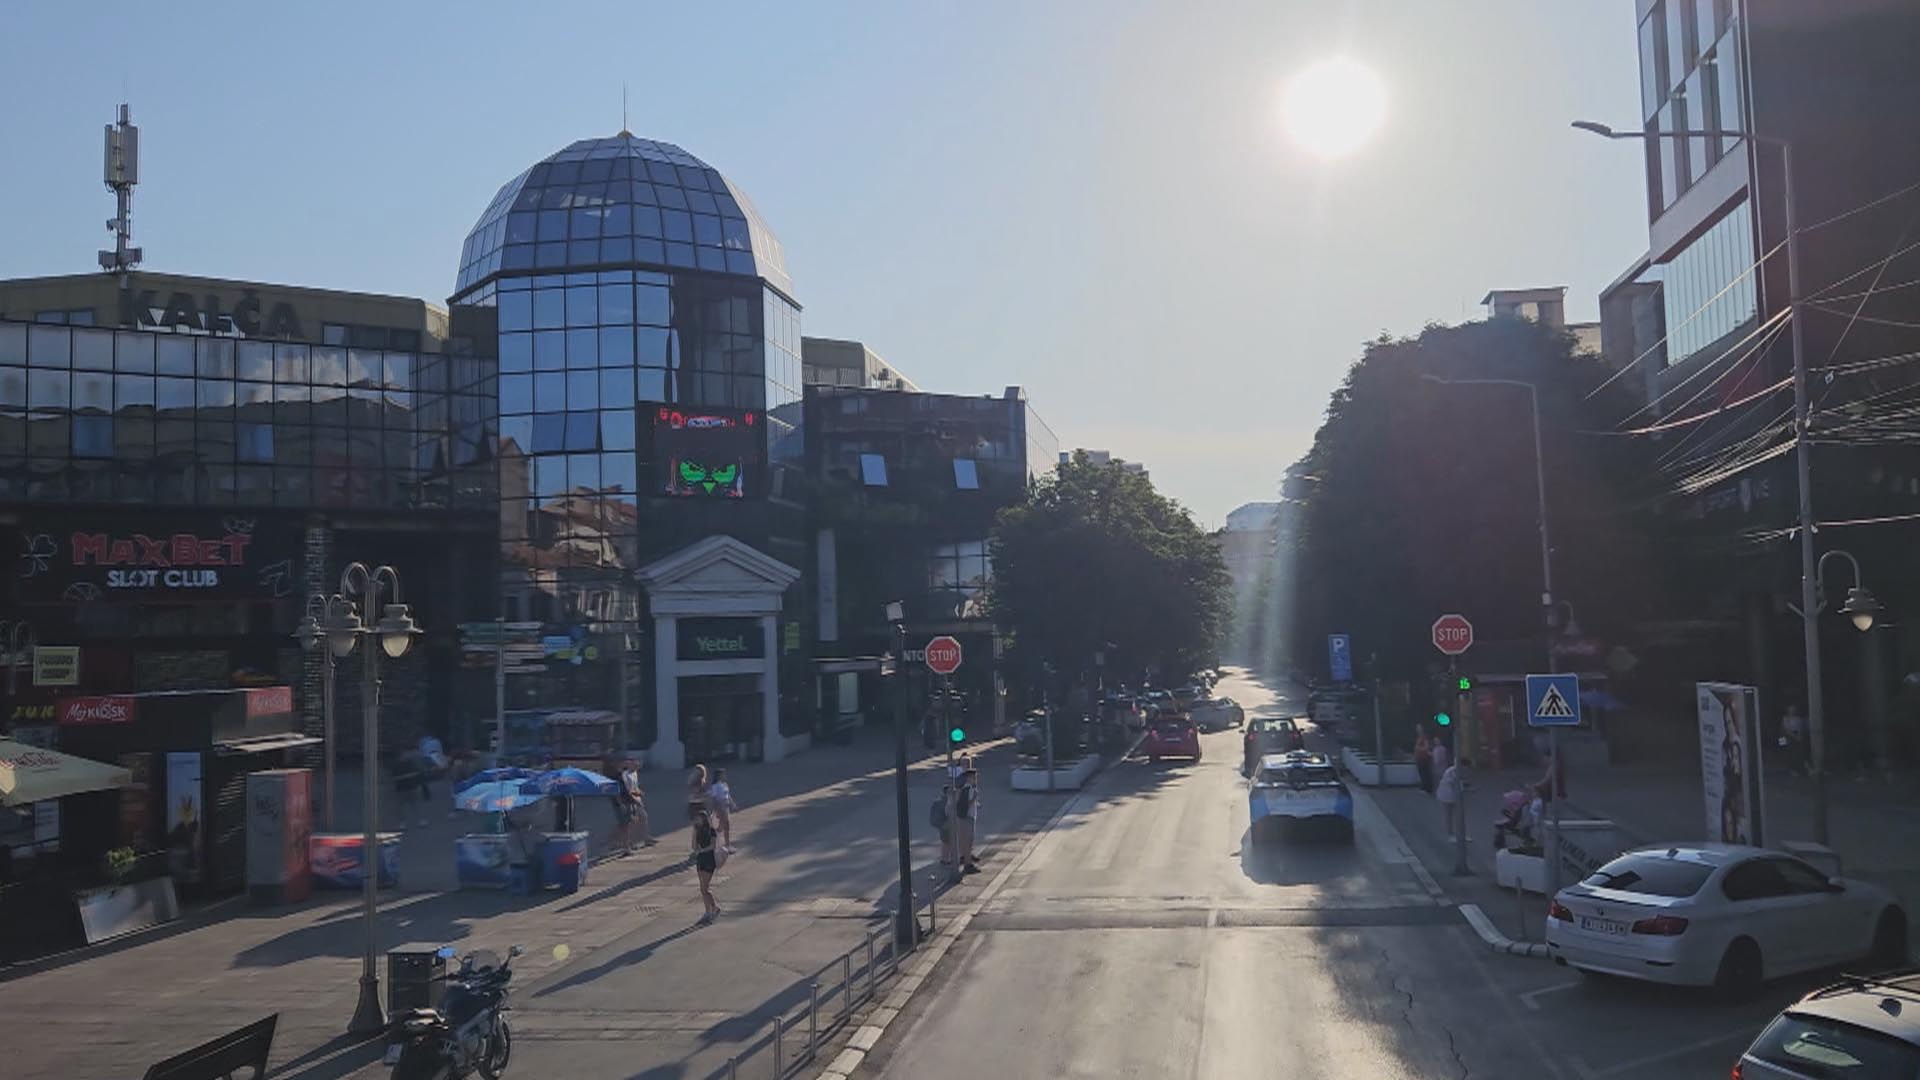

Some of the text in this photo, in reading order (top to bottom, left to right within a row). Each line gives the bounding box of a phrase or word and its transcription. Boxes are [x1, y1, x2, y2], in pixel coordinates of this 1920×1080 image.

[120, 289, 302, 340] KALČA
[107, 569, 218, 588] SLOT CLUB
[1437, 628, 1466, 642] STOP
[1333, 638, 1344, 653] P
[930, 650, 956, 662] STOP
